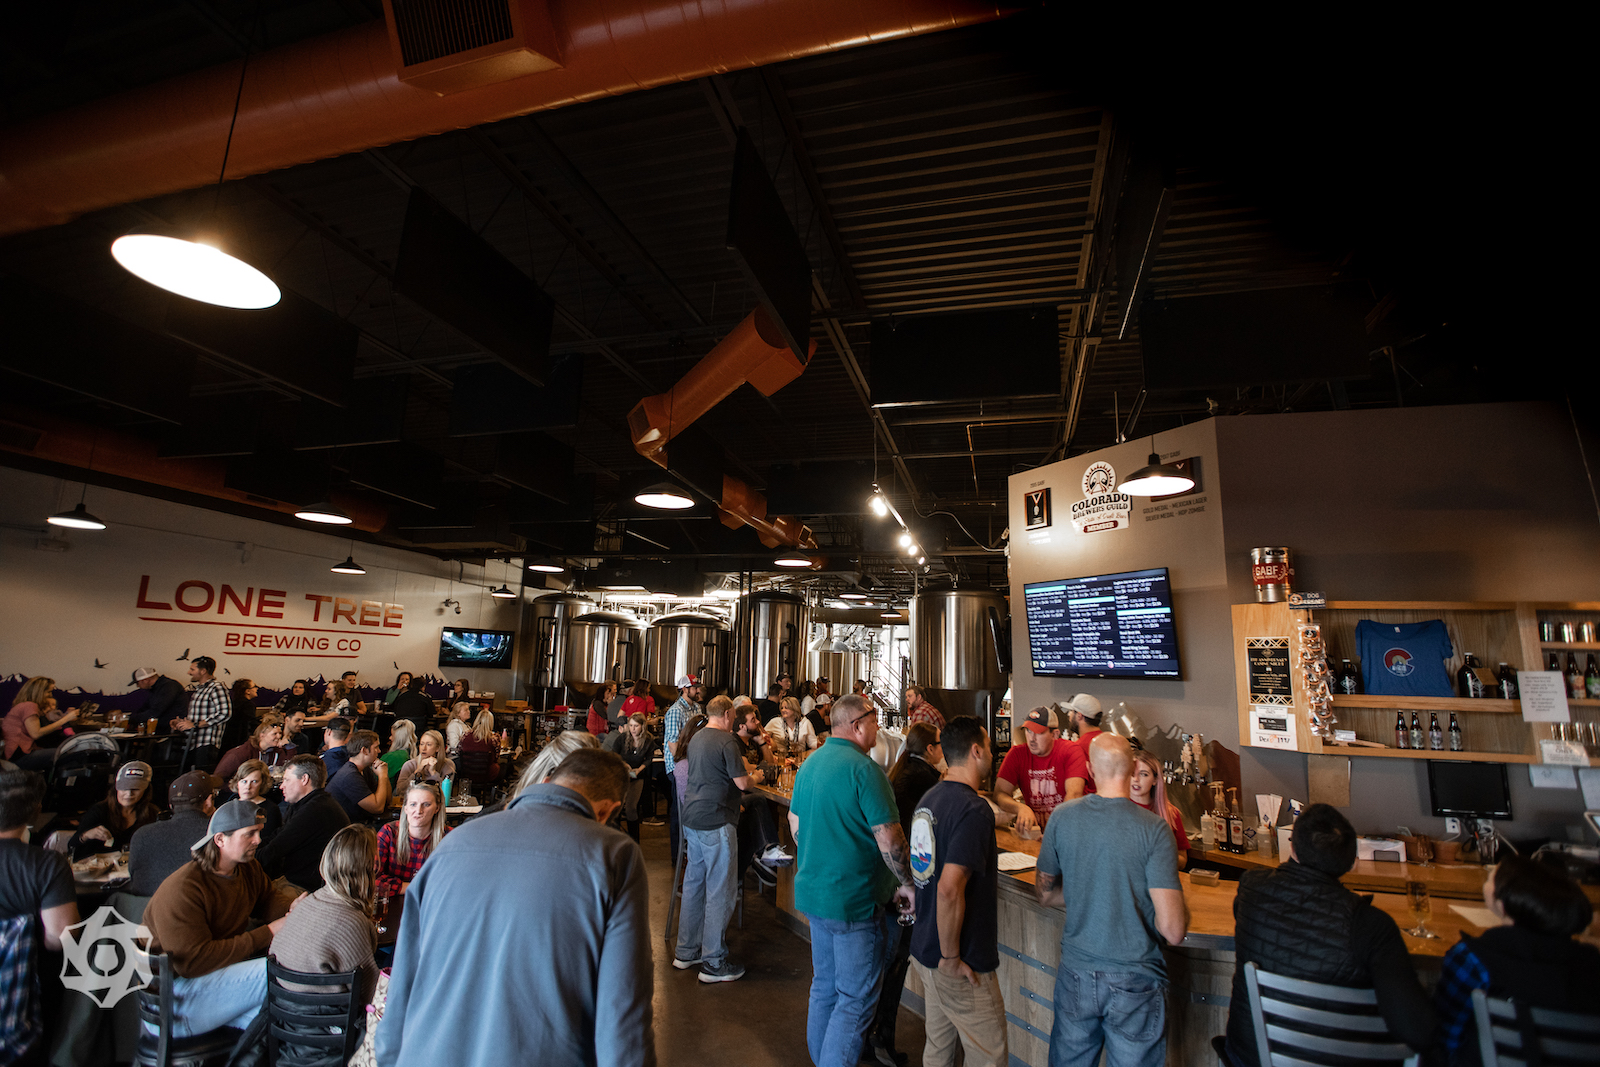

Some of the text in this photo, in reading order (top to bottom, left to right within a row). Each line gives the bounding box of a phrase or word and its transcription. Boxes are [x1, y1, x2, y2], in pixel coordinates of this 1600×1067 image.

[1072, 493, 1129, 513] COLORADO
[1073, 502, 1129, 520] BREWERS GUILD
[1172, 500, 1192, 509] MEXICAN
[1192, 496, 1208, 505] LAGER
[1160, 511, 1175, 519] MEDAL
[1255, 565, 1279, 577] GABF
[136, 575, 404, 628] LONE TREE
[224, 632, 361, 652] BREWING CO
